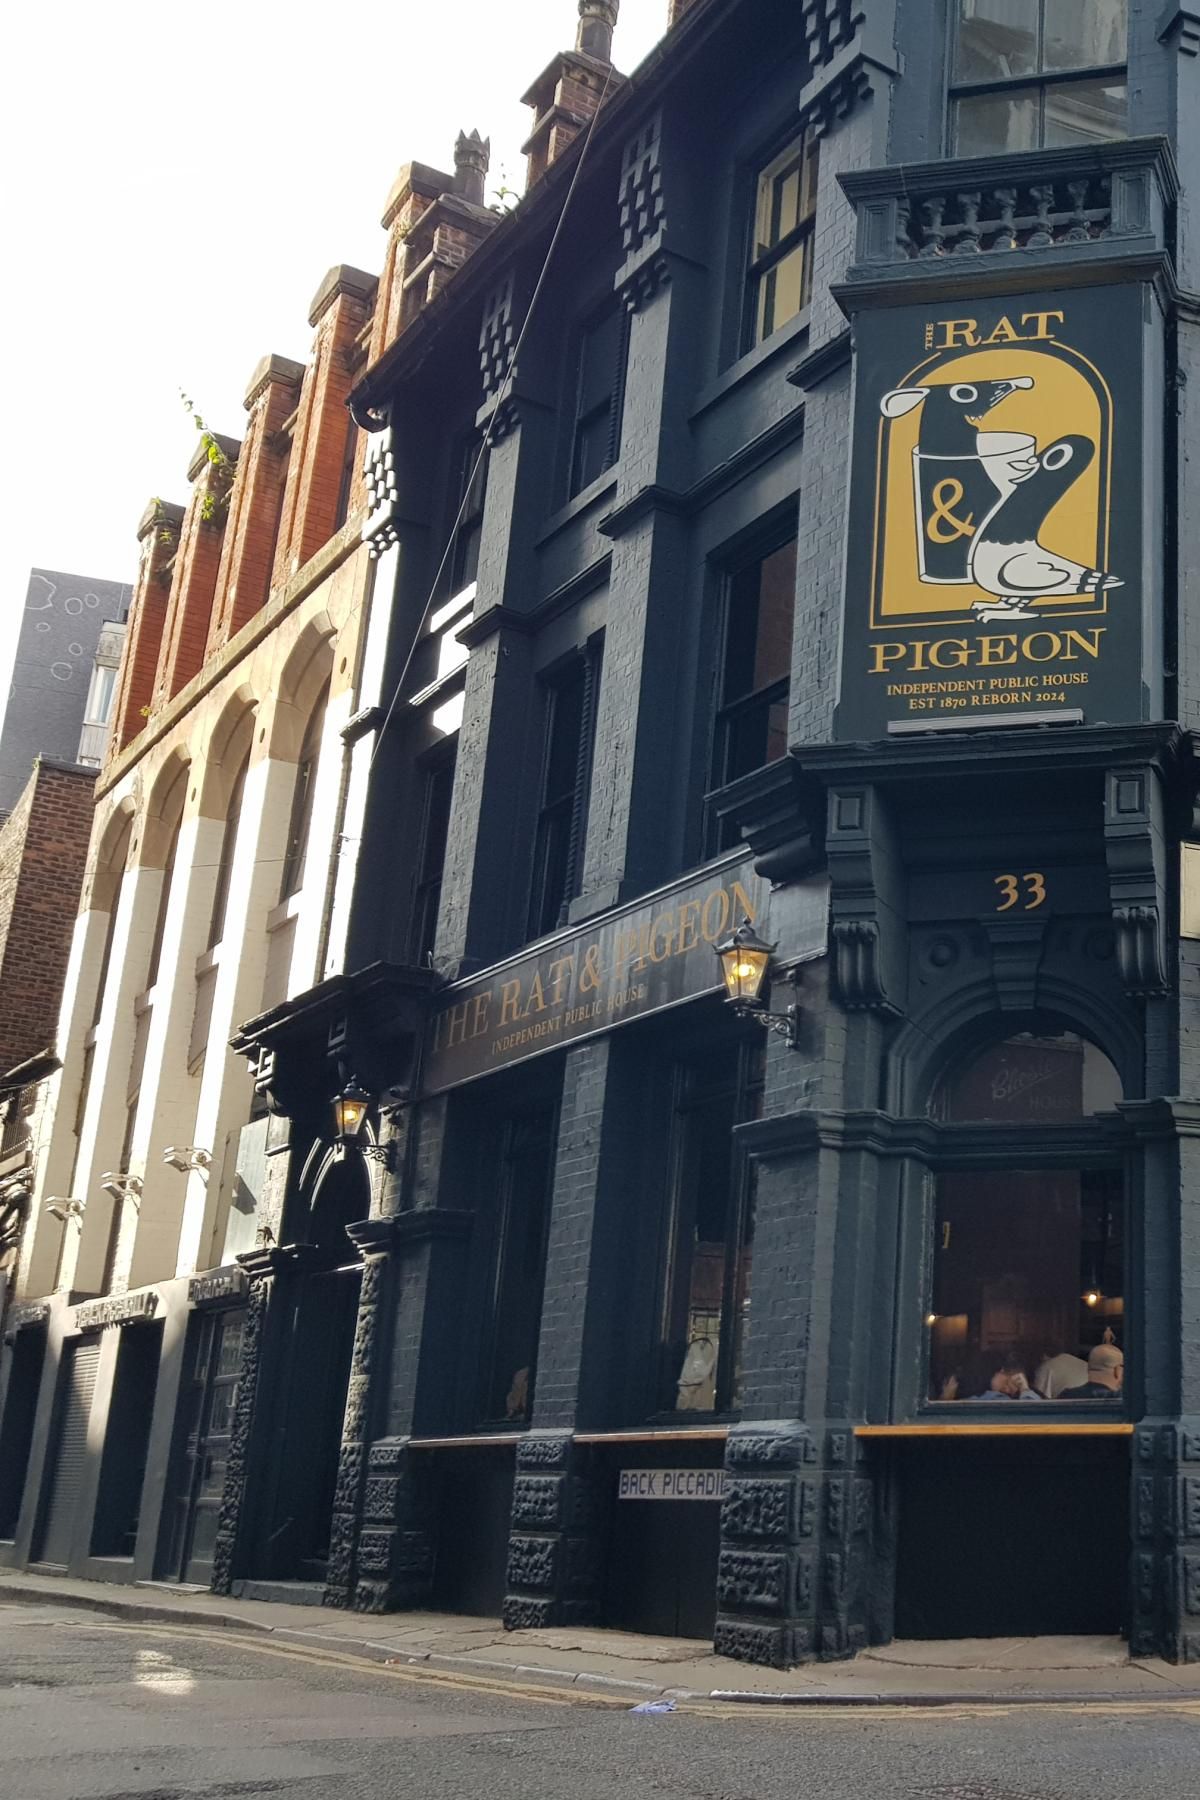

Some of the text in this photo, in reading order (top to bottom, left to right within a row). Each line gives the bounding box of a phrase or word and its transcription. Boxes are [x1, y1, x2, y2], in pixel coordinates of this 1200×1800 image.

[924, 322, 934, 350] THE
[935, 310, 1064, 349] RAT
[926, 478, 976, 544] &
[867, 627, 1107, 673] PIGEON
[887, 672, 1089, 696] INDEPENDENT PUBLIC HOUSE
[909, 691, 1066, 710] EST 1870 REBORN 2024
[994, 872, 1047, 912] 33
[431, 880, 757, 1055] THE RAT & PIGEON
[492, 983, 645, 1054] INDEPENDENT PUBLIC HOUSE
[620, 1472, 657, 1496] BACK
